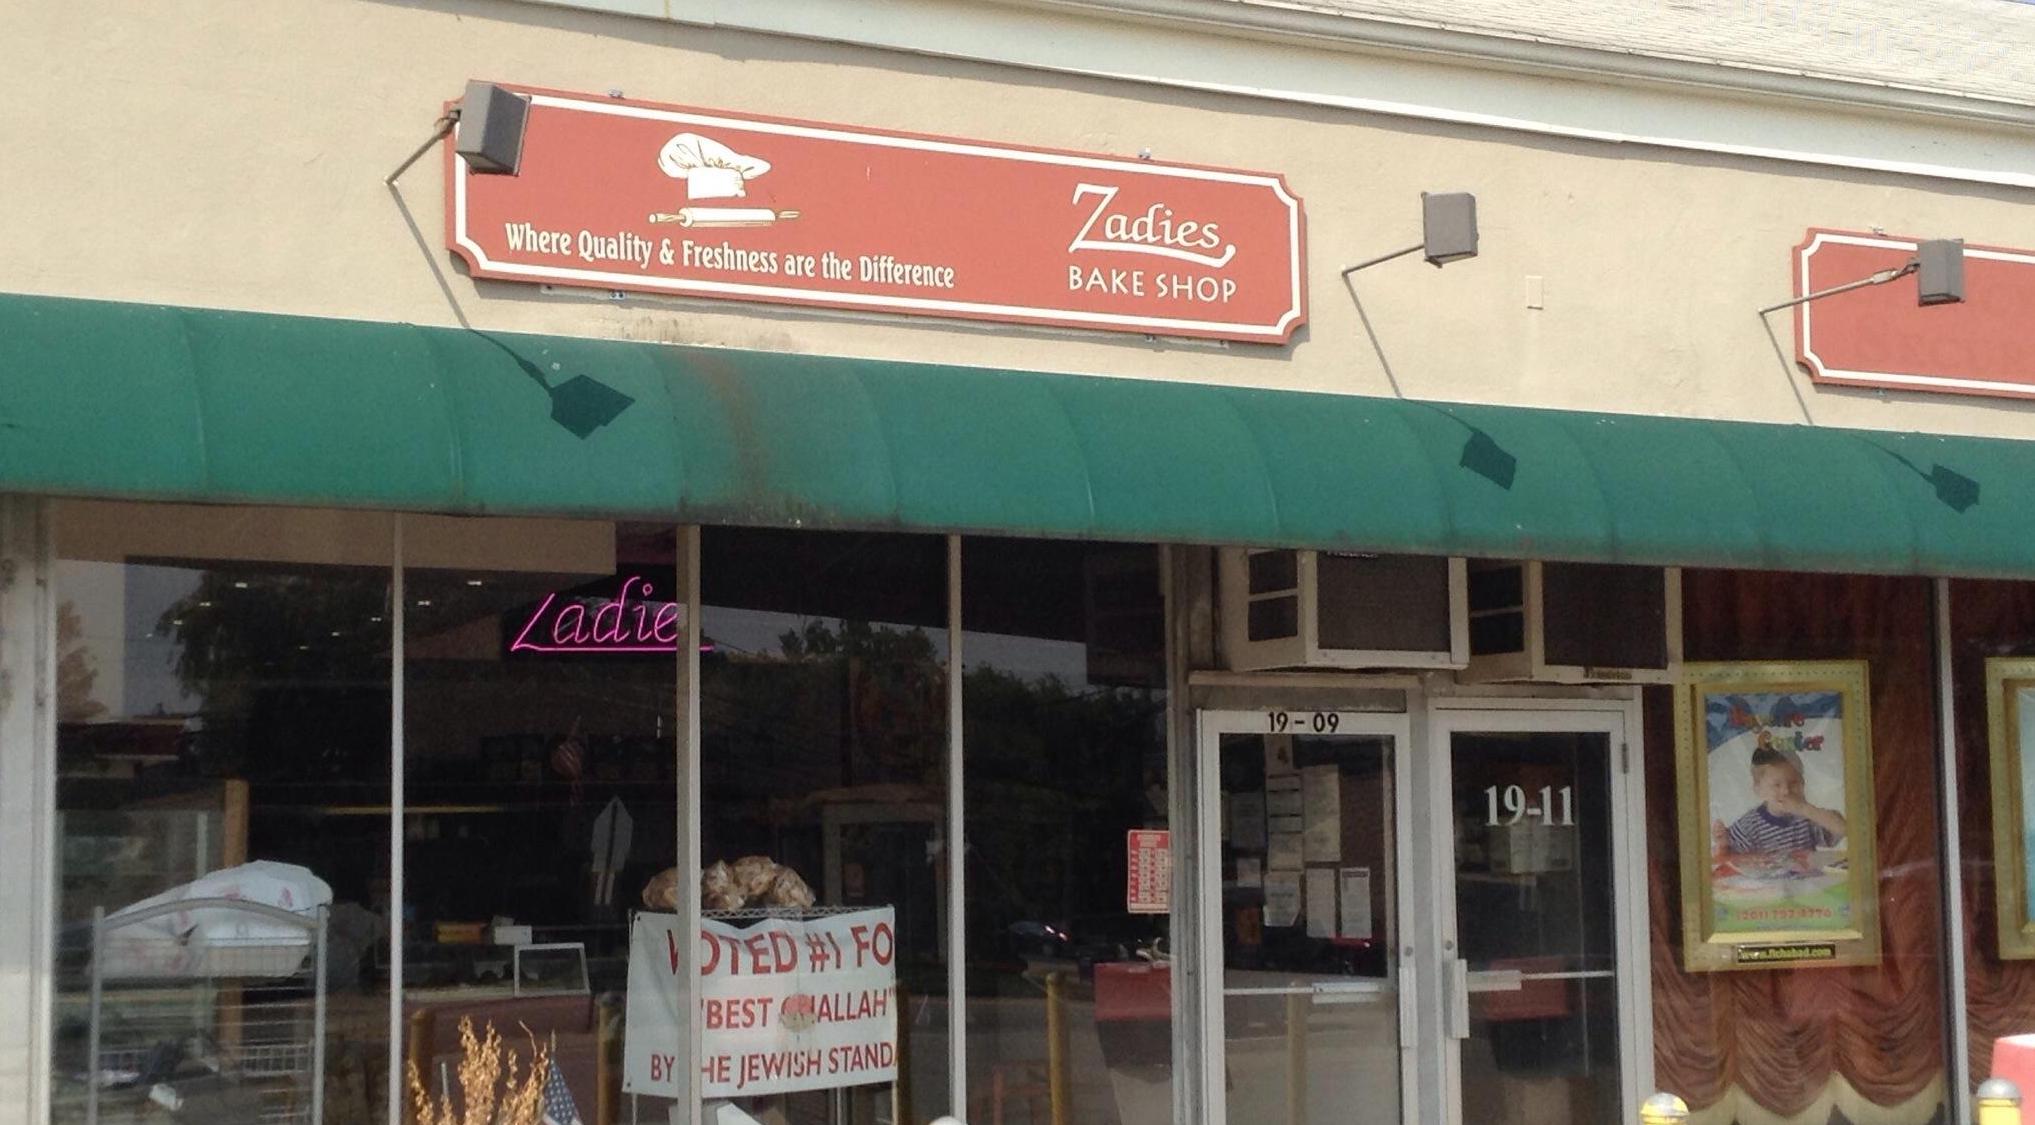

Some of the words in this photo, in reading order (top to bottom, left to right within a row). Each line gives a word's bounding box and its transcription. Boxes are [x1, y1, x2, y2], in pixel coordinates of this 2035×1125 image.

[1068, 183, 1236, 268] Zadies
[505, 222, 572, 255] Where
[578, 230, 653, 269] Quality
[659, 238, 675, 265] &
[682, 239, 778, 274] Freshness
[784, 253, 816, 277] are
[821, 251, 852, 280] the
[859, 255, 955, 288] Difference
[1069, 265, 1144, 296] BAKE
[1155, 273, 1236, 303] SHOP
[511, 576, 713, 652] Zadie
[1484, 784, 1575, 826] 19-11
[805, 931, 842, 973] #1
[651, 1054, 676, 1083] BY
[700, 1055, 731, 1084] HE
[737, 1048, 822, 1090] JEWISH
[828, 1041, 898, 1075] STAND
